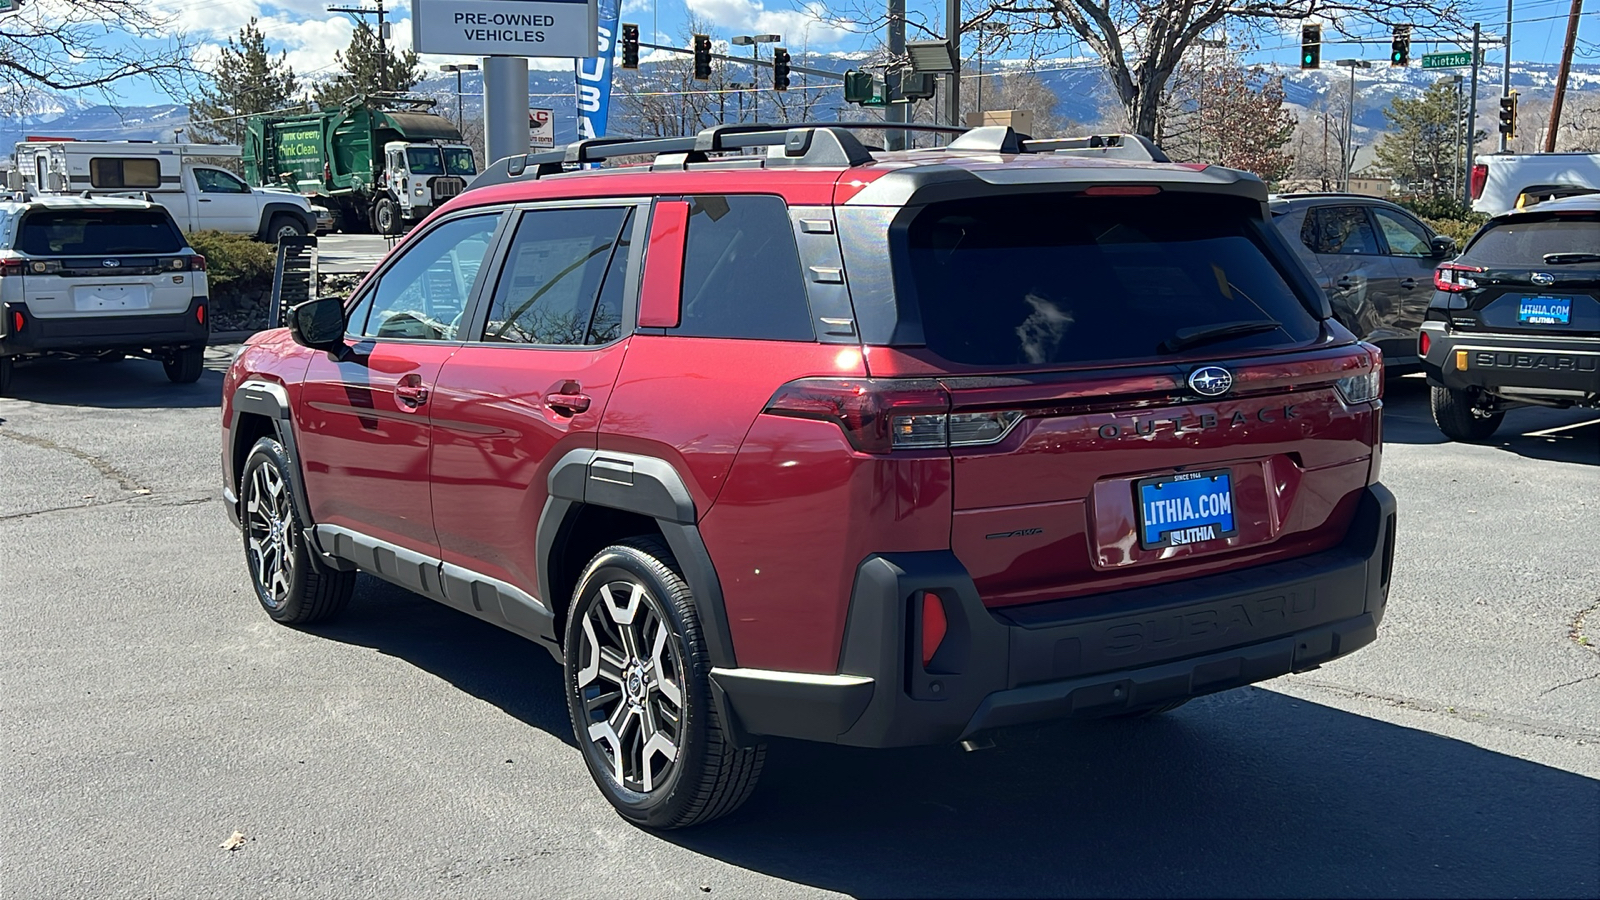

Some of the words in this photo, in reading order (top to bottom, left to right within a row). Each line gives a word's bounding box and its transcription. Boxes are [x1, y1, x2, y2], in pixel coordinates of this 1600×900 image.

[454, 12, 555, 28] PRE-OWNED
[464, 29, 546, 43] VEHICLES
[1431, 55, 1466, 67] Kietzke
[296, 143, 318, 156] Clean.
[1519, 304, 1570, 316] LITHIA.COM
[1475, 352, 1598, 372] SUBARU
[1097, 404, 1299, 440] OUTBACK
[1174, 473, 1190, 482] SINCE
[1143, 491, 1232, 527] LITHIA.COM
[1181, 526, 1216, 545] LITHIA
[1103, 586, 1318, 656] SUBARU
